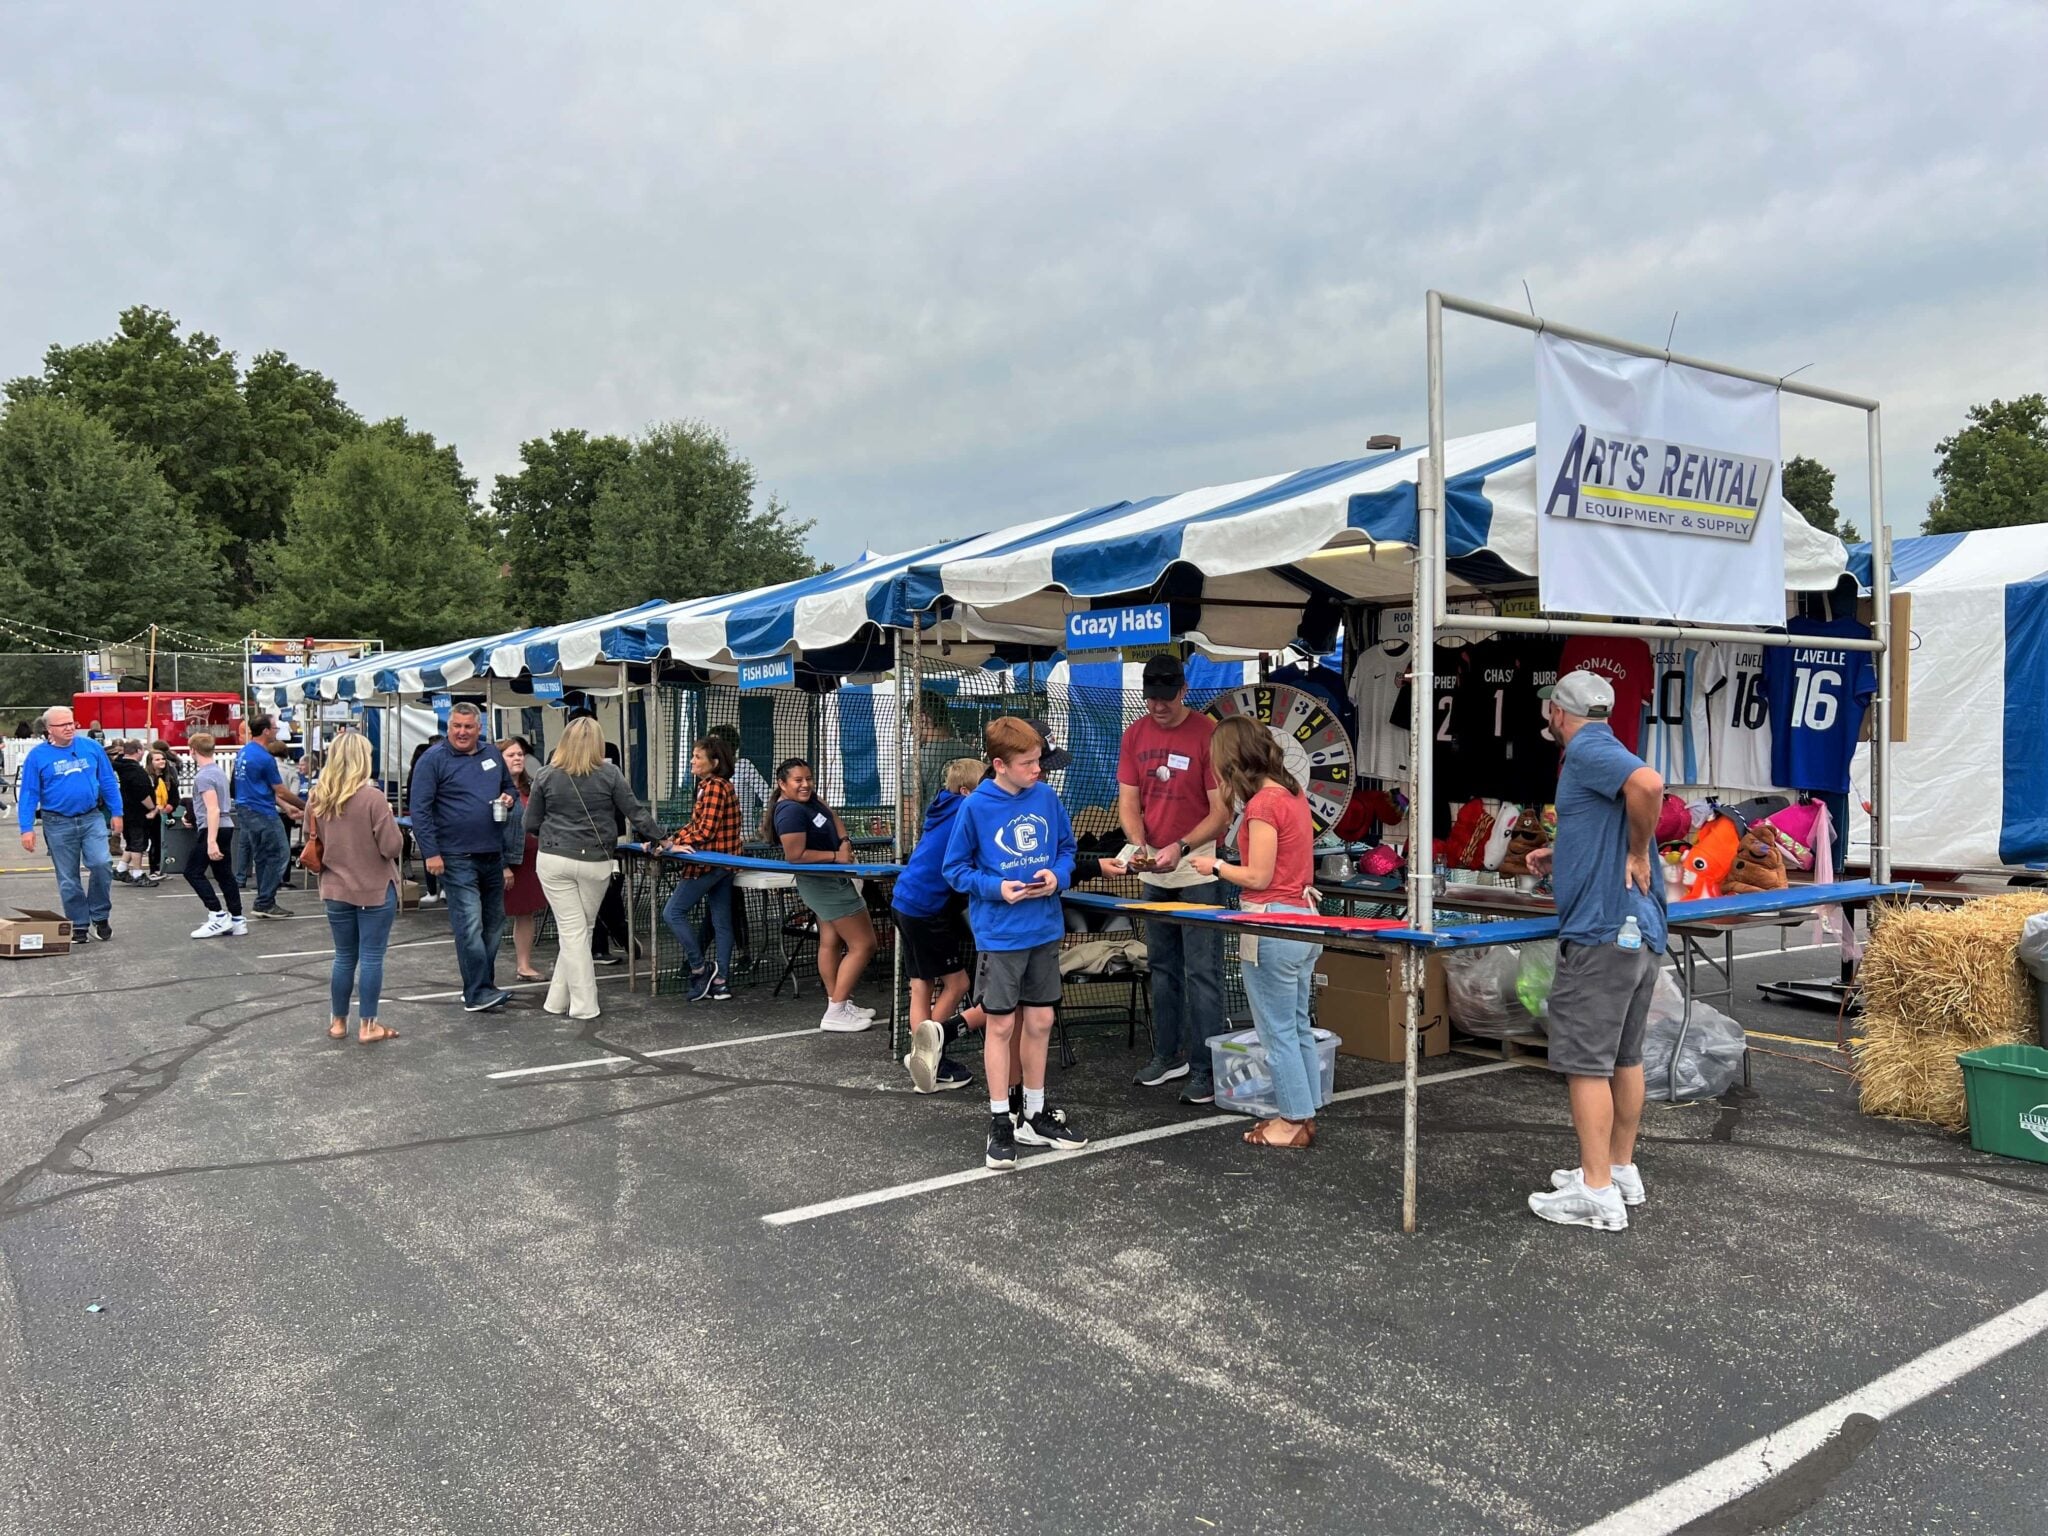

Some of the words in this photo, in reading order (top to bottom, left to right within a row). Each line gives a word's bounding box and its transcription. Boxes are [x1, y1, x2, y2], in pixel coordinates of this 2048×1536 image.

[1545, 424, 1648, 518] ART'S
[1659, 445, 1758, 507] RENTAL
[1585, 501, 1675, 526] EQUIPMENT
[1681, 516, 1693, 528] &
[1697, 517, 1750, 535] SUPPLY
[1505, 601, 1536, 613] LYTLE
[1070, 614, 1118, 639] Crazy
[1121, 609, 1163, 632] Hats
[743, 666, 761, 681] FISH
[762, 661, 789, 678] BOWL
[1651, 653, 1681, 664] ESSI
[1794, 649, 1846, 665] LAVELLE
[1484, 669, 1514, 683] CHAS
[1494, 690, 1504, 737] 1
[1731, 671, 1768, 730] 16
[1791, 667, 1842, 730] 16
[1437, 696, 1453, 741] 2
